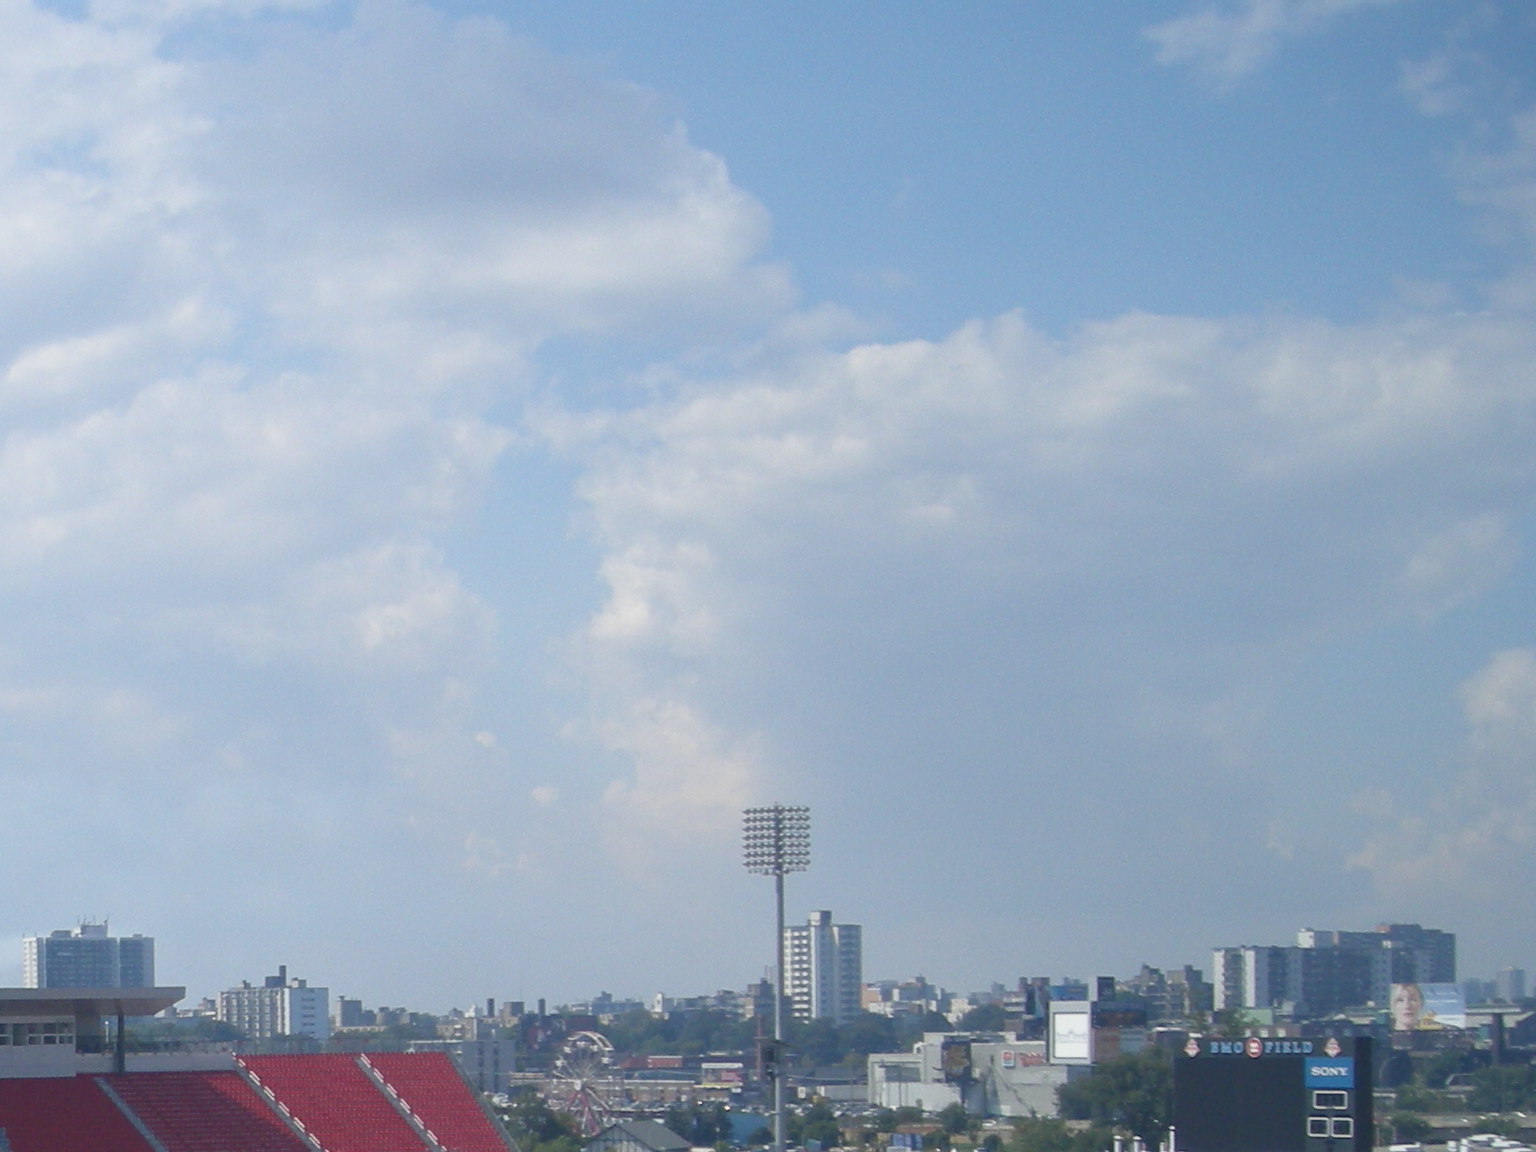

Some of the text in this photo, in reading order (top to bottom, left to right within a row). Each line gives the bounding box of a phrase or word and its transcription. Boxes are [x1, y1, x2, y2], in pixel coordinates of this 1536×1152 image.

[1210, 1041, 1313, 1053] BMO FIELD
[1311, 1066, 1348, 1076] SONY
